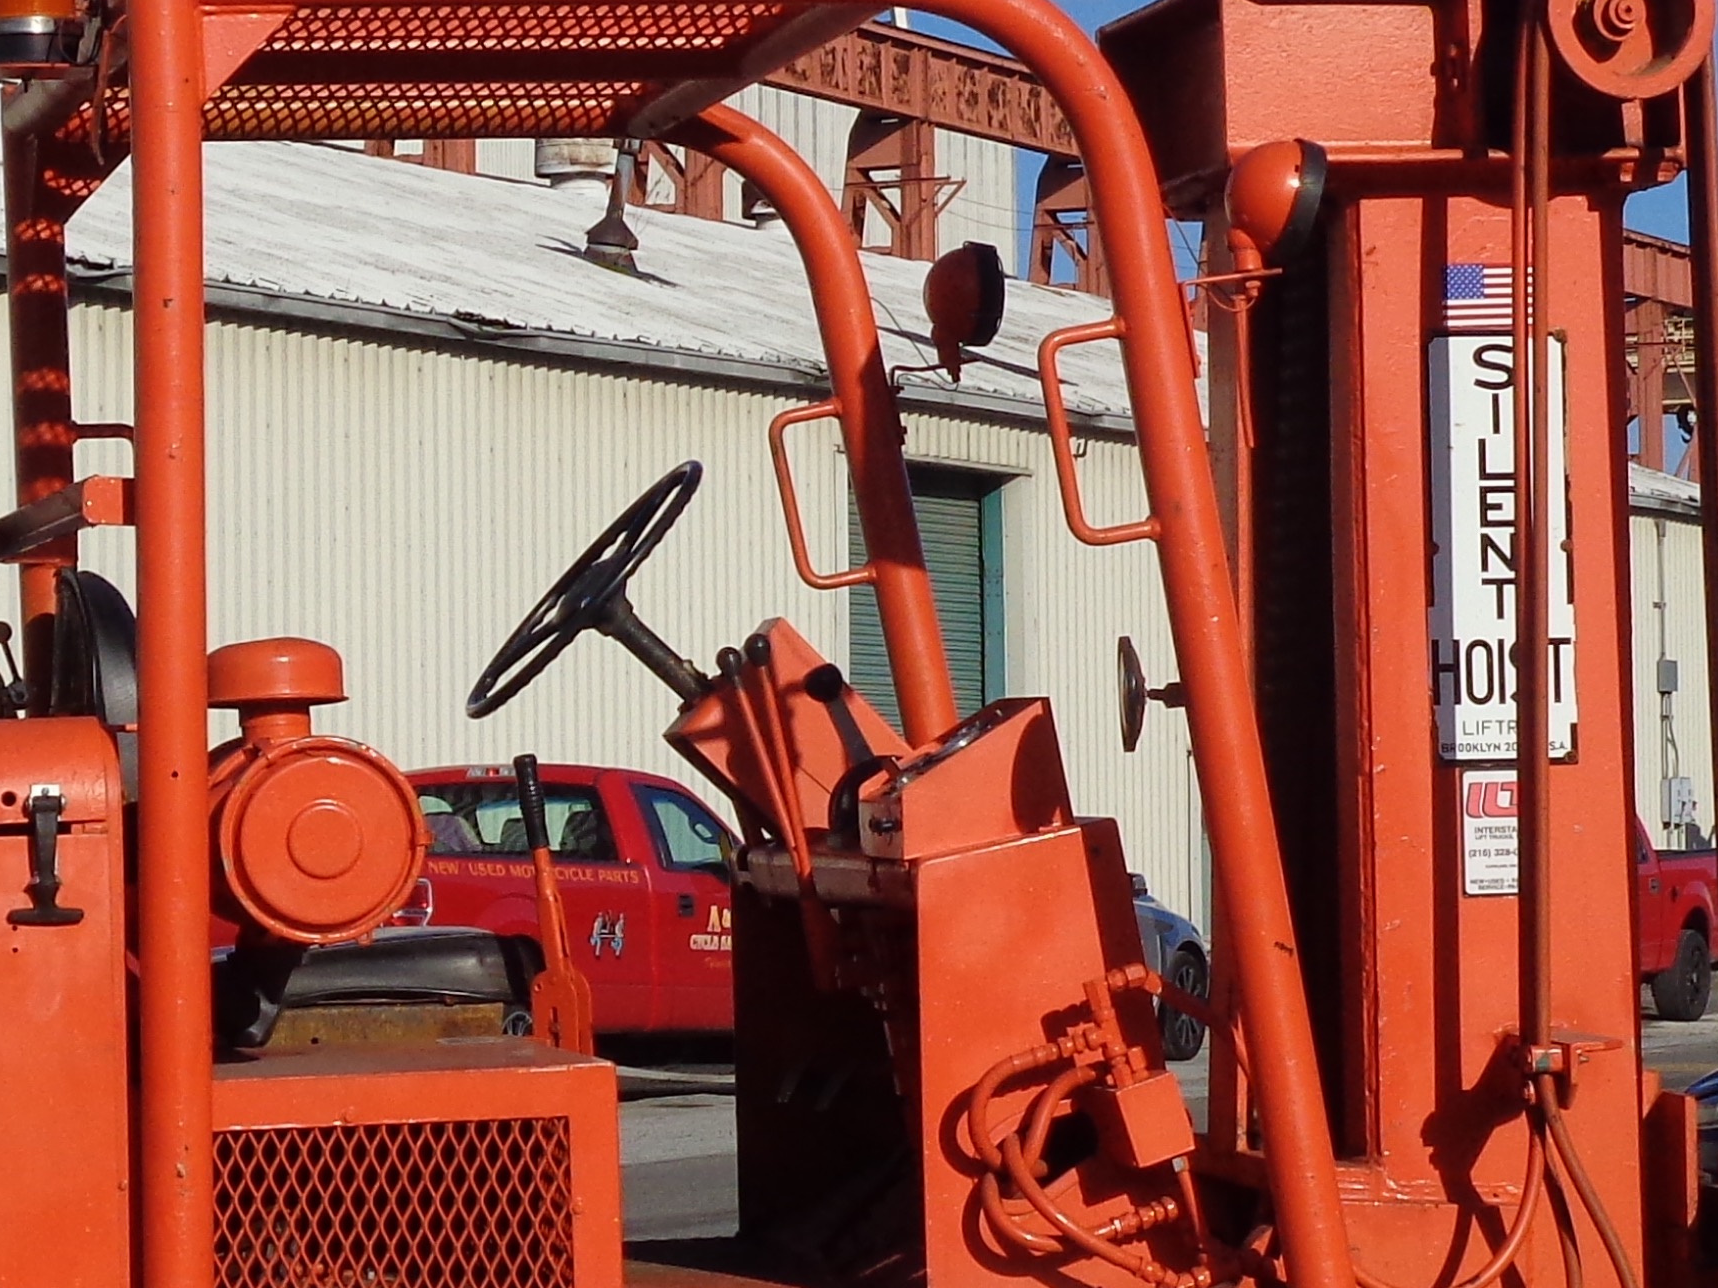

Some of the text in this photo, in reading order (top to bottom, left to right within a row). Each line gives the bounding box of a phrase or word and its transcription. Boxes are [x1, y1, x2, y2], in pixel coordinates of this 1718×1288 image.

[1472, 344, 1517, 620] SILENT
[1431, 637, 1572, 705] HOIT
[1462, 719, 1518, 736] LIFTR
[1441, 741, 1501, 753] BROOKLYN
[1474, 825, 1518, 834] INTERSTA
[427, 860, 639, 884] NEW USED MOTCYCLE PARTS
[707, 905, 721, 932] A
